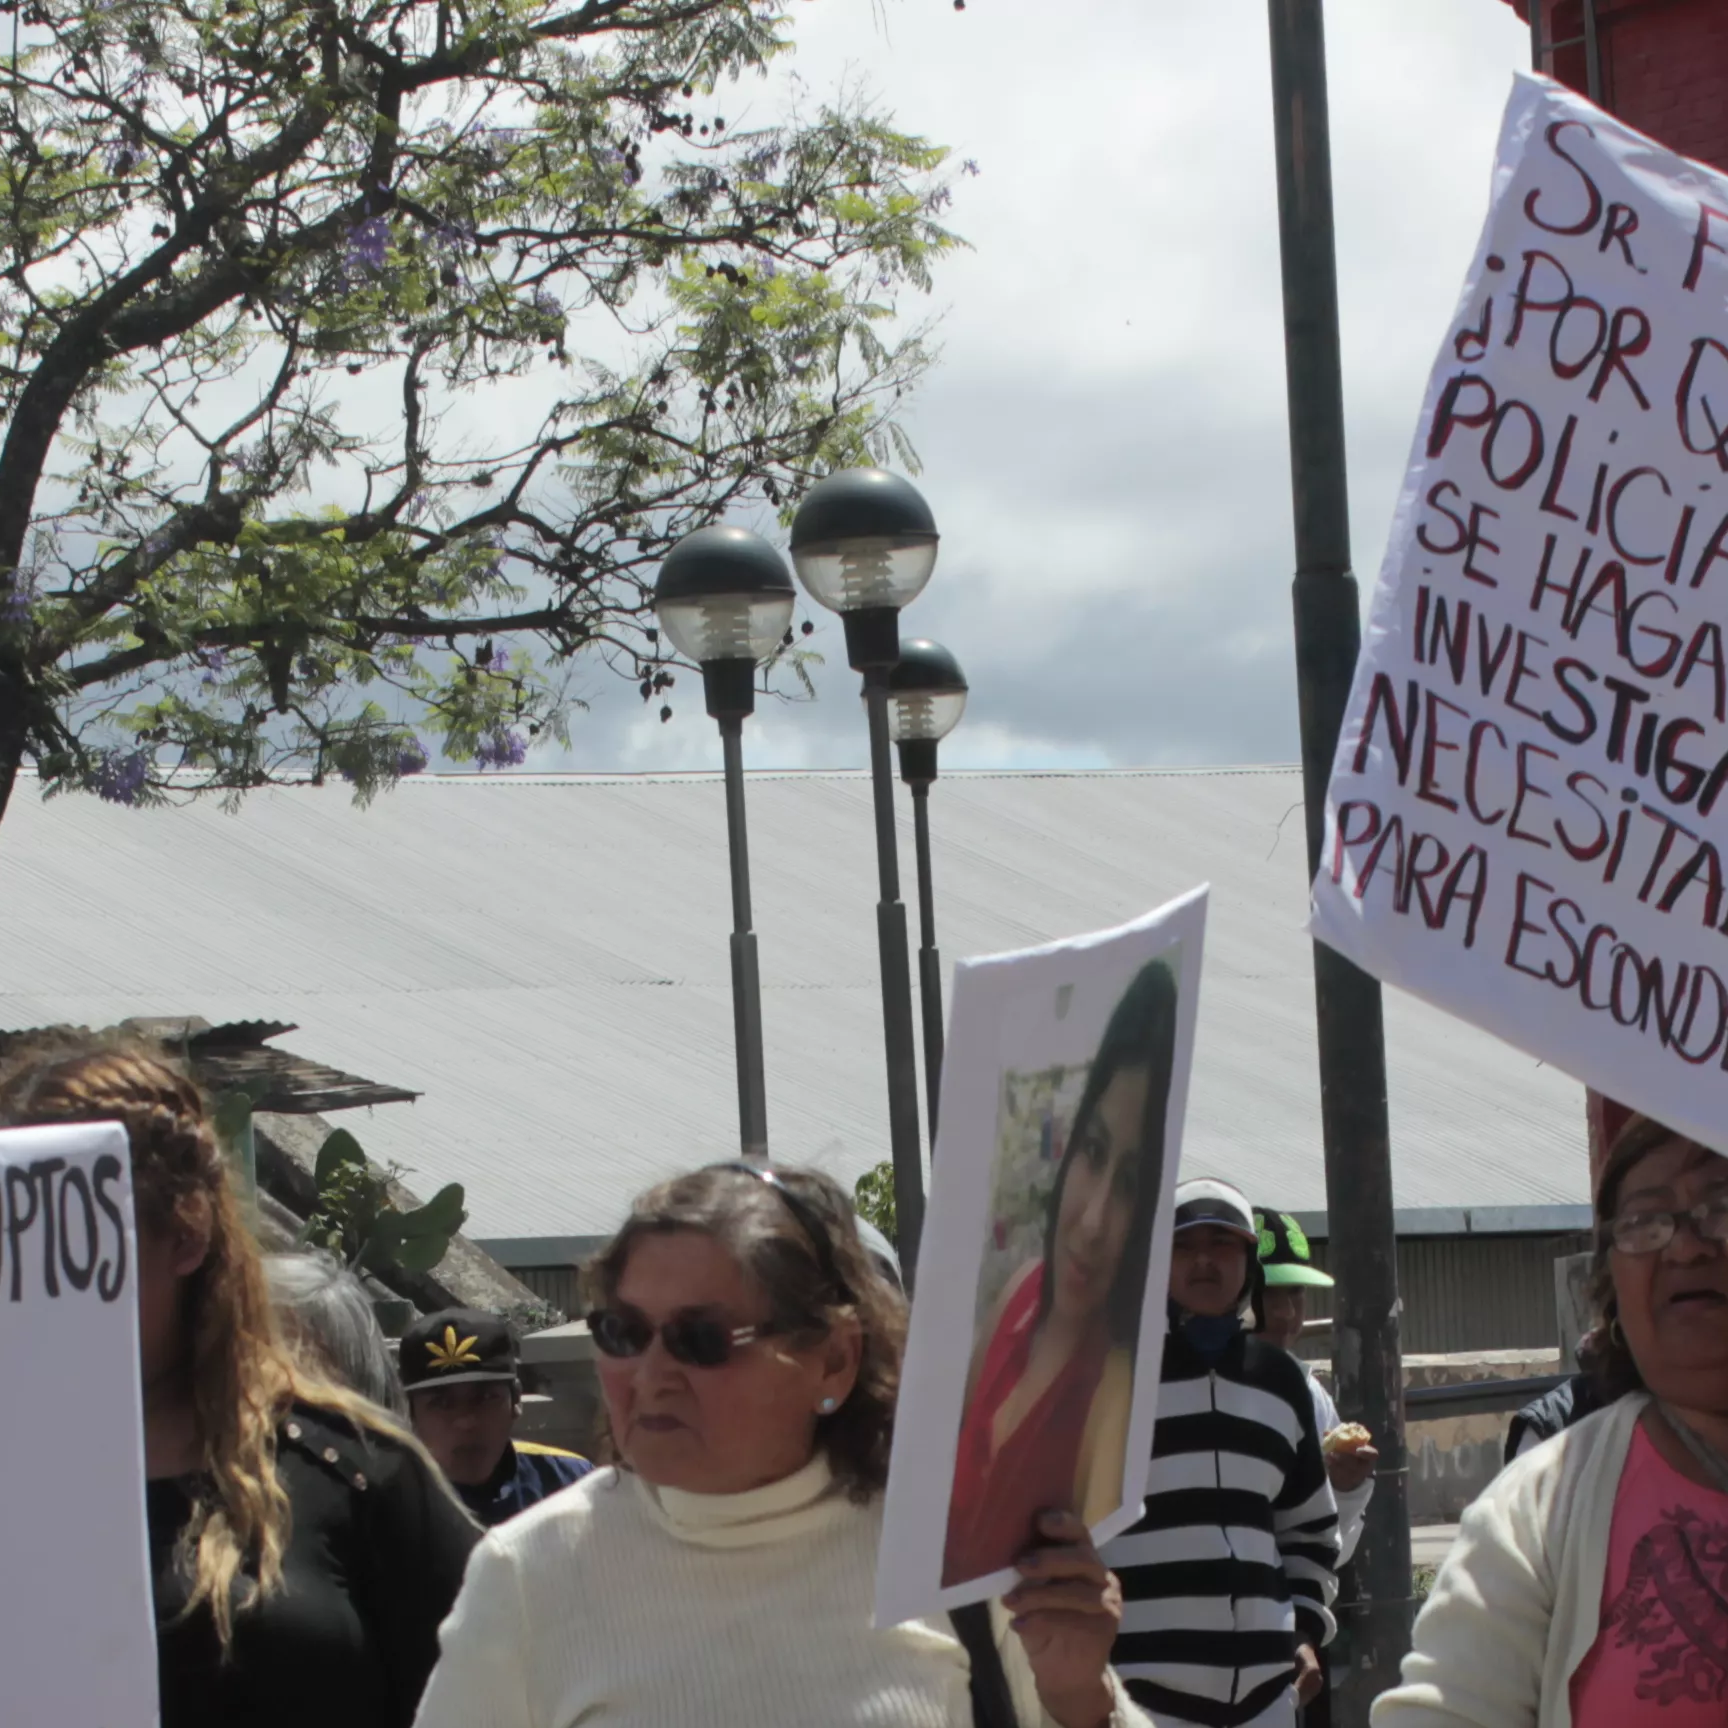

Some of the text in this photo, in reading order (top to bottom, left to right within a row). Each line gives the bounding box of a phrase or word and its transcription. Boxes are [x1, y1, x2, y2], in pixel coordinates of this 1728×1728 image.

[1417, 480, 1500, 588] SE
[1530, 532, 1725, 722] HAGA
[1335, 800, 1488, 949] PARA
